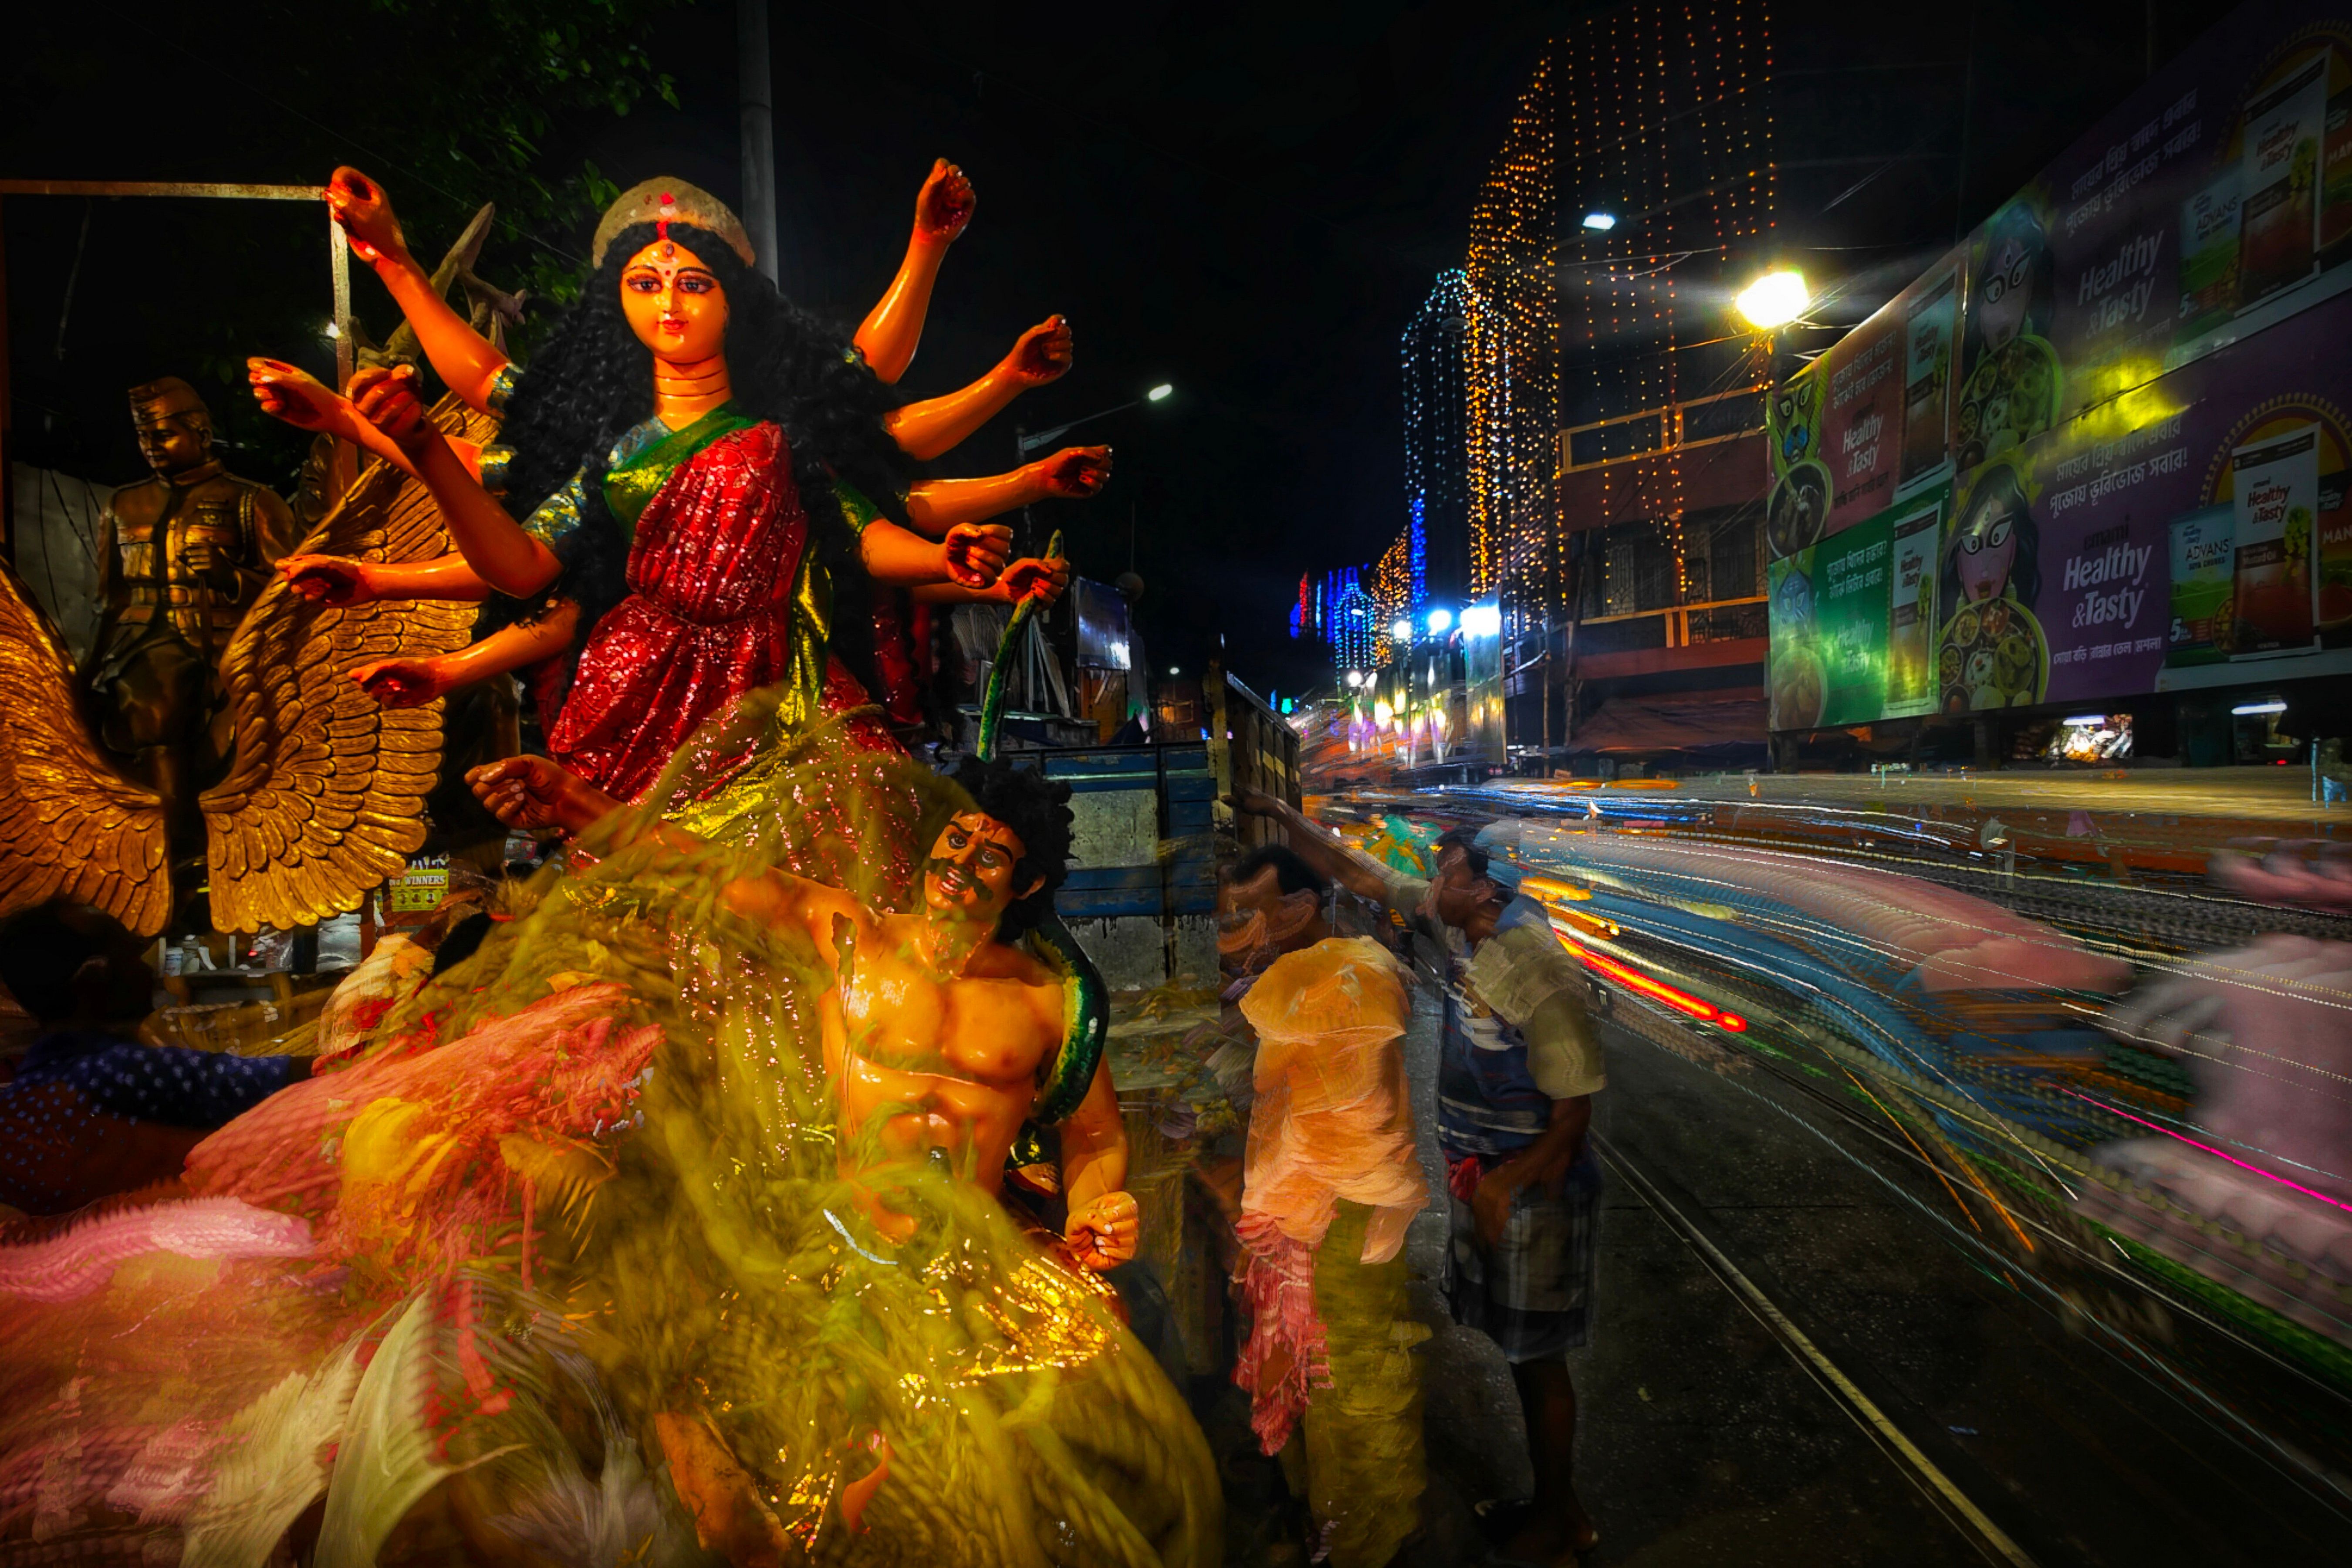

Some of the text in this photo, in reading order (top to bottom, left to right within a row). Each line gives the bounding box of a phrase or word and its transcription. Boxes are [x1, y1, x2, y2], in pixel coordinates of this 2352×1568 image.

[2078, 230, 2164, 306] Healthy
[2085, 277, 2155, 340] &Tasty
[1842, 413, 1884, 454] Healthy
[1847, 444, 1879, 478] &Tasty
[2149, 446, 2187, 477] সবার!
[2247, 485, 2290, 507] Healthy
[2063, 541, 2153, 591] Healthy
[2186, 539, 2229, 561] ADVANS
[2072, 586, 2145, 629] &Tasty
